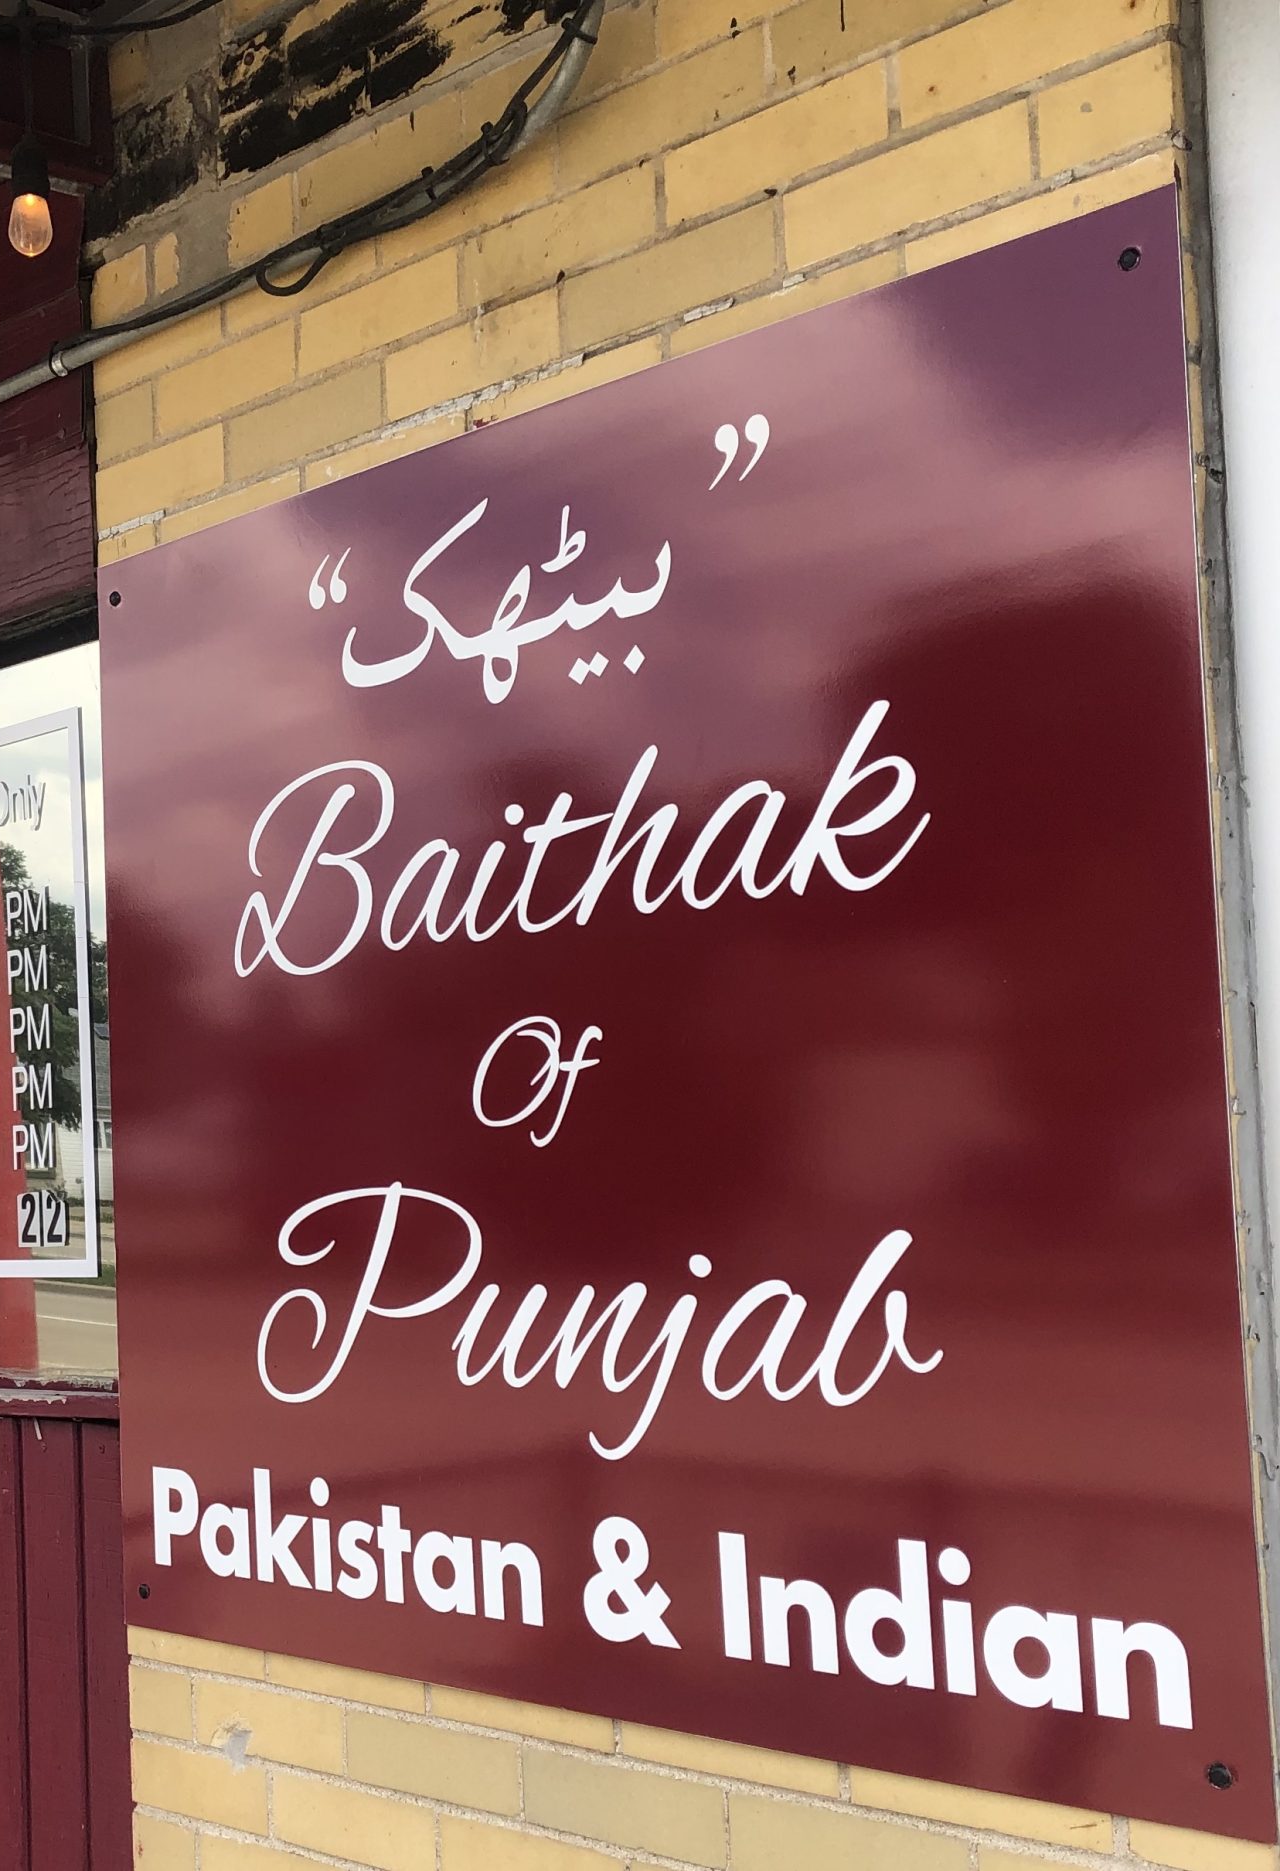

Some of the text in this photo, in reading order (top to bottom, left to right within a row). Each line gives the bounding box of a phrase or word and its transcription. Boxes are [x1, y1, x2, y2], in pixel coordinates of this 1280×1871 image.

[235, 700, 931, 977] Baithak
[6, 886, 49, 938] PM
[7, 944, 49, 996] PM
[9, 1003, 52, 1054] PM
[12, 1062, 54, 1112] PM
[473, 1016, 603, 1147] Of
[12, 1122, 55, 1171] PM
[257, 1181, 944, 1461] Punjab
[152, 1466, 1195, 1730] Pakistan & Indian
